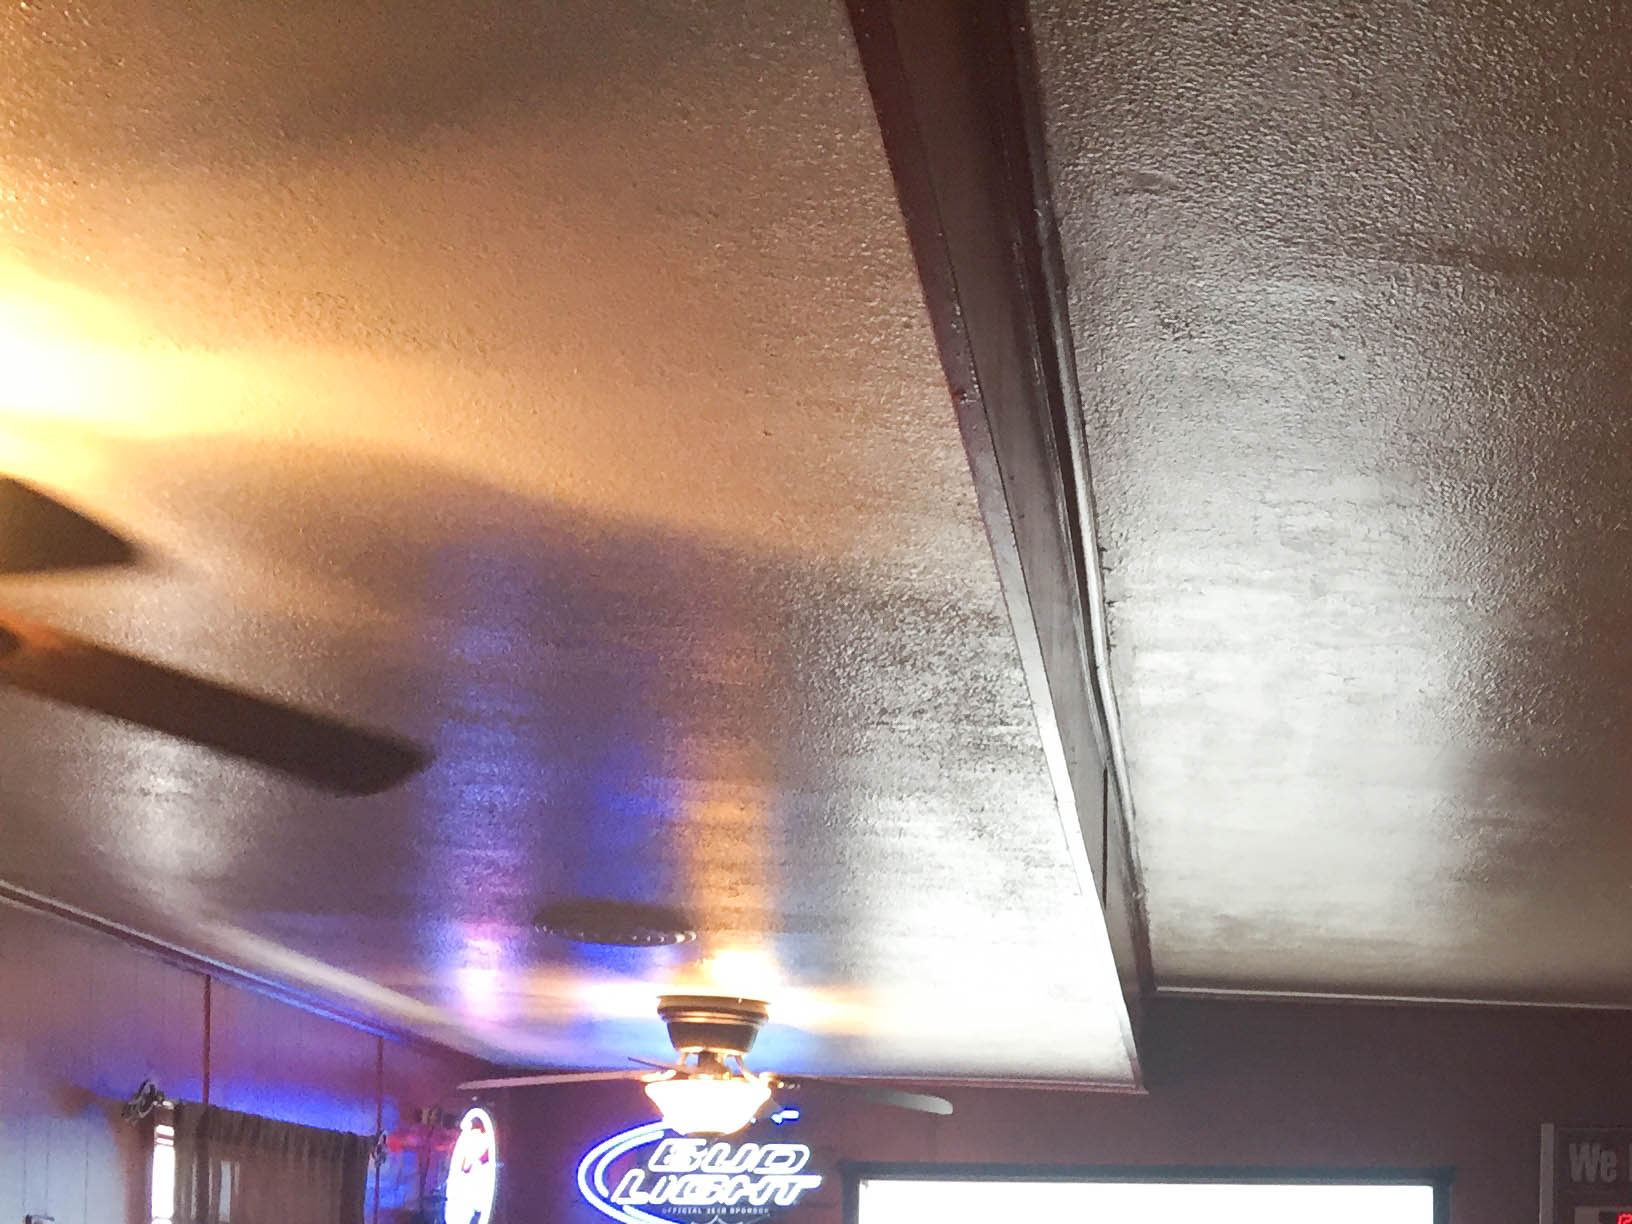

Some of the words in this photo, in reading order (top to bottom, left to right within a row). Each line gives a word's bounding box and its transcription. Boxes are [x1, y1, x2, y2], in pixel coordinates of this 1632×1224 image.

[648, 1138, 811, 1175] BUD
[1568, 1143, 1617, 1183] We
[611, 1168, 823, 1206] LIGHT
